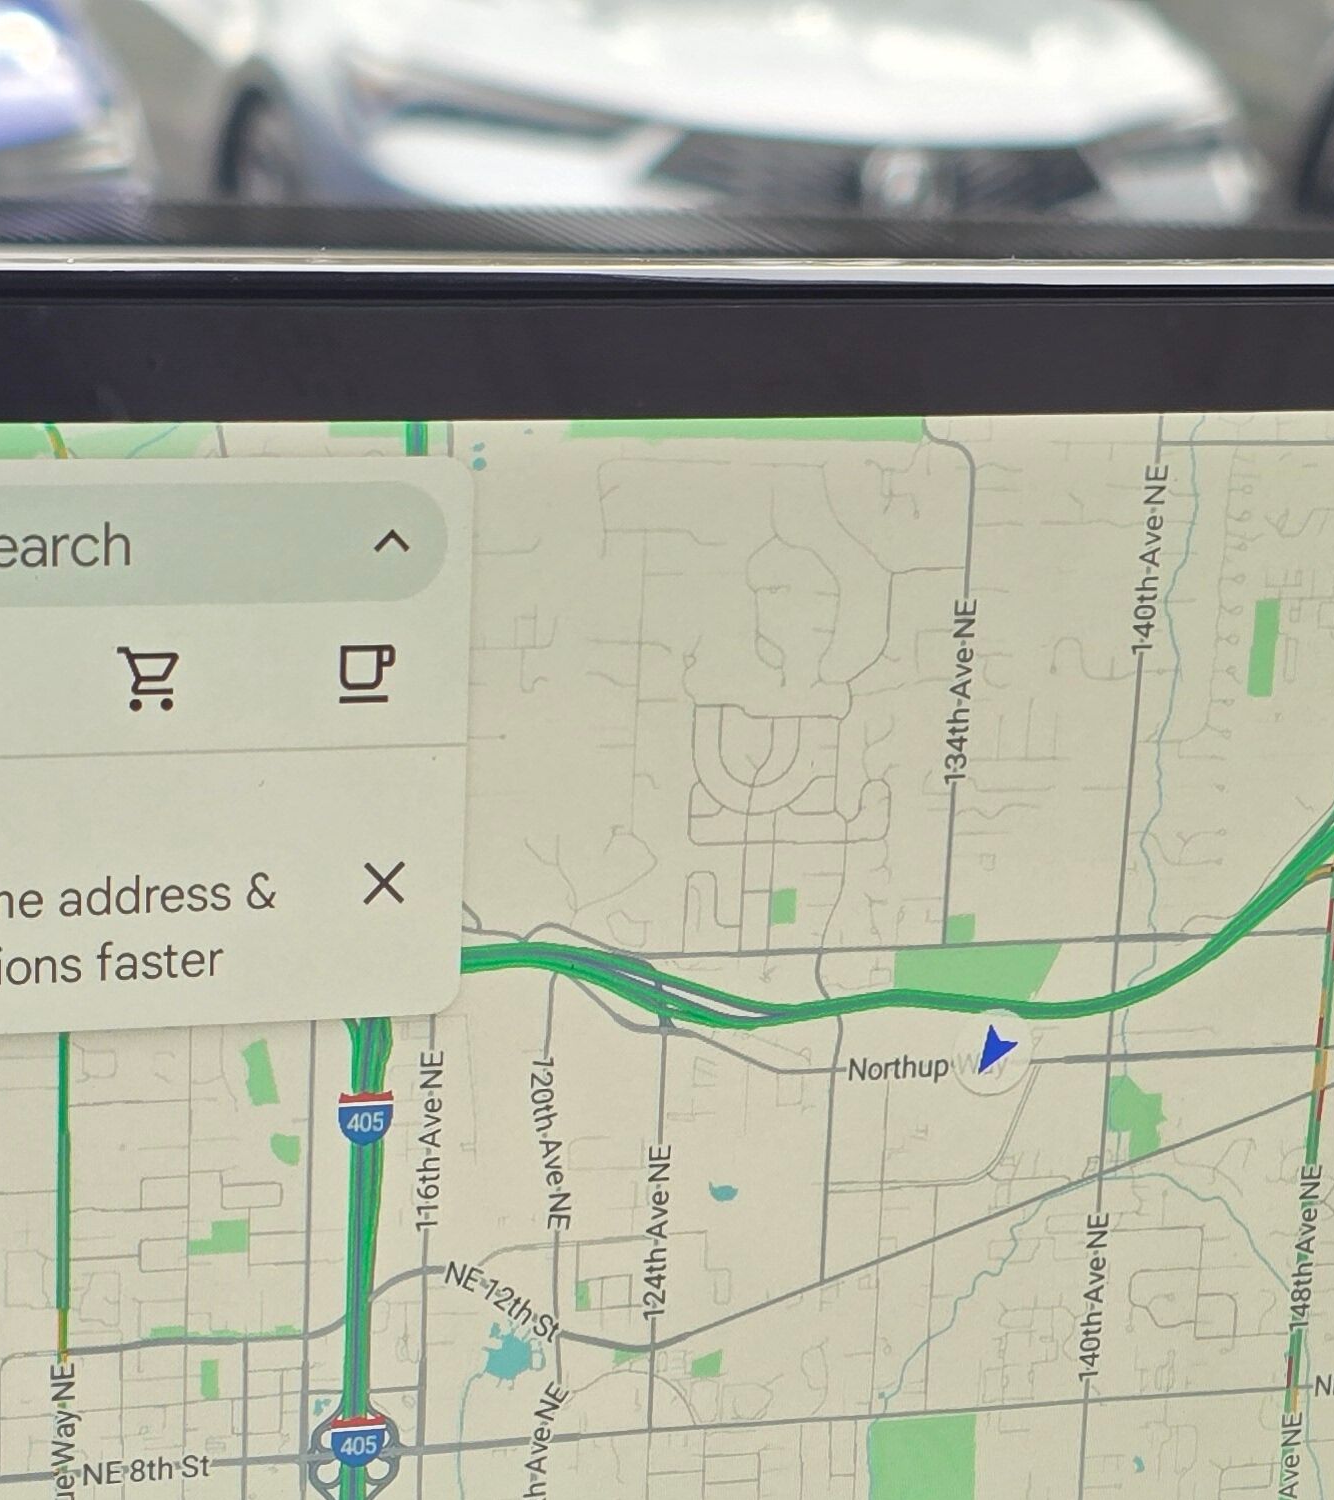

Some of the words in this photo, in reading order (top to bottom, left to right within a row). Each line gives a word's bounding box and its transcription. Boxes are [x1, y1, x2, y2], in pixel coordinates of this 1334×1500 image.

[1144, 465, 1168, 504] NE
[1139, 515, 1164, 567] Ave
[953, 599, 977, 638] NE
[1131, 576, 1159, 655] 140th
[949, 648, 974, 699] Ave
[944, 708, 970, 785] 134th
[59, 877, 232, 919] address
[245, 872, 277, 912] &
[97, 941, 224, 981] faster
[420, 1051, 444, 1088] NE
[848, 1055, 949, 1083] Northup
[530, 1057, 558, 1132] 120th
[347, 1112, 384, 1132] 405
[419, 1097, 443, 1148] Ave
[539, 1139, 564, 1186] Ave
[648, 1145, 671, 1182] NE
[1299, 1165, 1322, 1201] NE
[416, 1157, 440, 1231] 116th
[547, 1192, 571, 1230] NE
[646, 1191, 669, 1239] Ave
[1086, 1213, 1109, 1248] NE
[1295, 1207, 1317, 1254] Ave
[444, 1261, 484, 1292] NE
[485, 1279, 532, 1326] 12th
[533, 1313, 559, 1343] St
[643, 1248, 666, 1320] 124th
[1083, 1257, 1106, 1303] Ave
[1290, 1262, 1313, 1331] 148th
[1079, 1312, 1102, 1381] 140th
[50, 1363, 75, 1401] NE
[535, 1381, 569, 1422] NE
[51, 1410, 82, 1467] Way
[340, 1435, 377, 1456] 405
[524, 1426, 551, 1474] Ave
[1281, 1412, 1302, 1447] NE
[83, 1461, 122, 1486] NE
[130, 1456, 173, 1482] 8th
[182, 1455, 210, 1478] St
[1279, 1455, 1300, 1499] Ave
